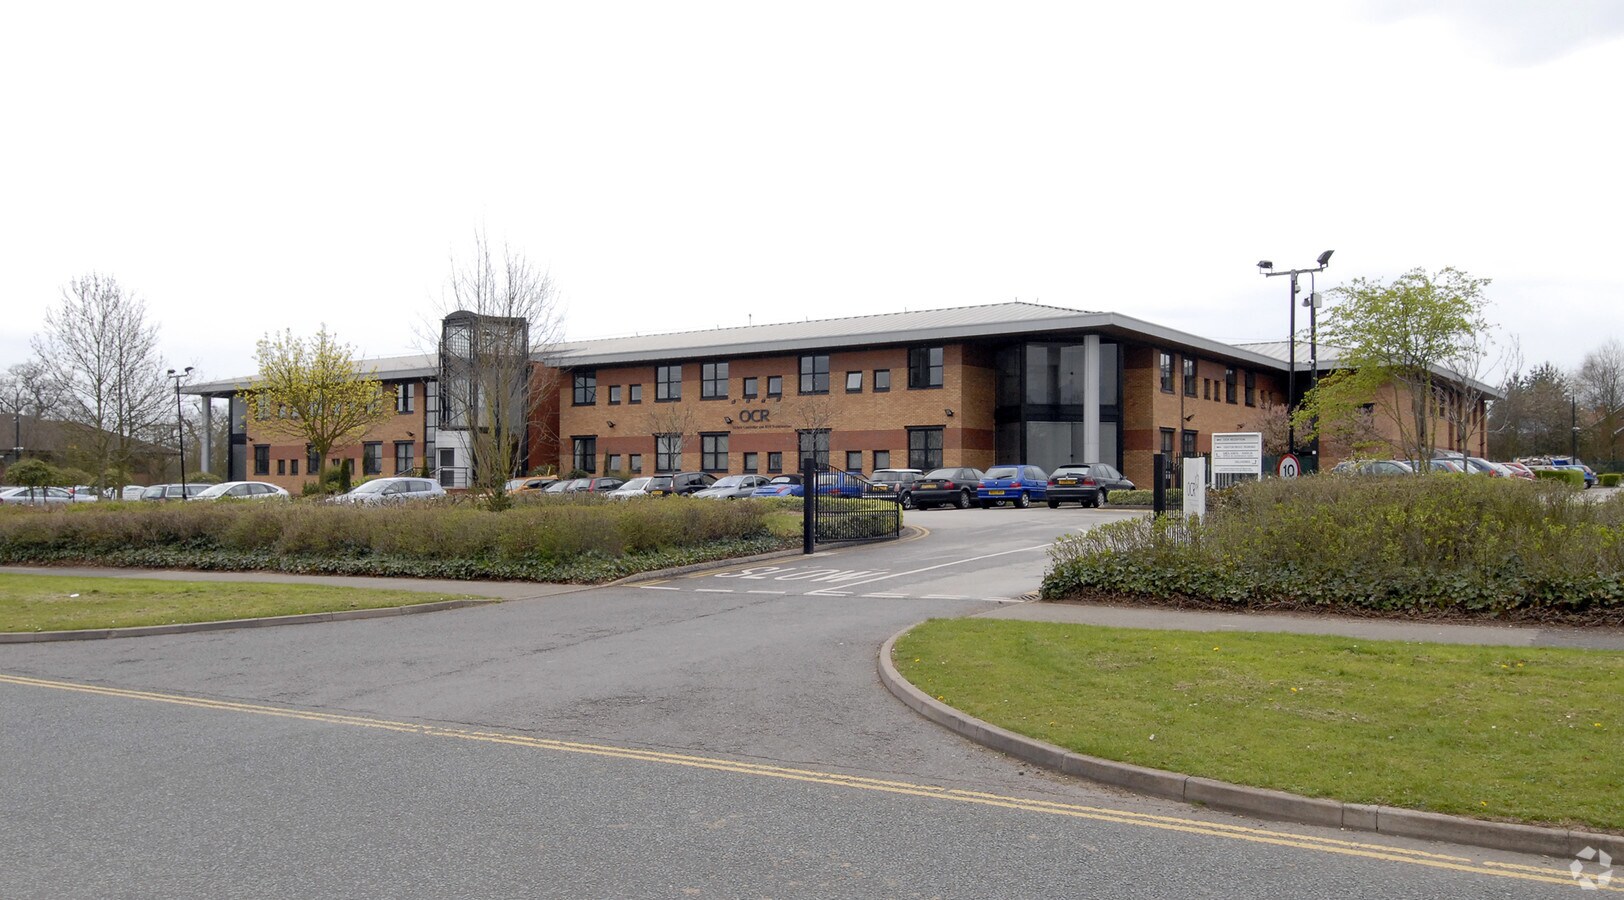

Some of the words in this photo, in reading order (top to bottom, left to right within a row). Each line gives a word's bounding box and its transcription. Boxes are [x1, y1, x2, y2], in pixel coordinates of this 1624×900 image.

[739, 409, 769, 422] OCR
[1283, 464, 1295, 477] 10
[714, 566, 888, 583] SLOW
